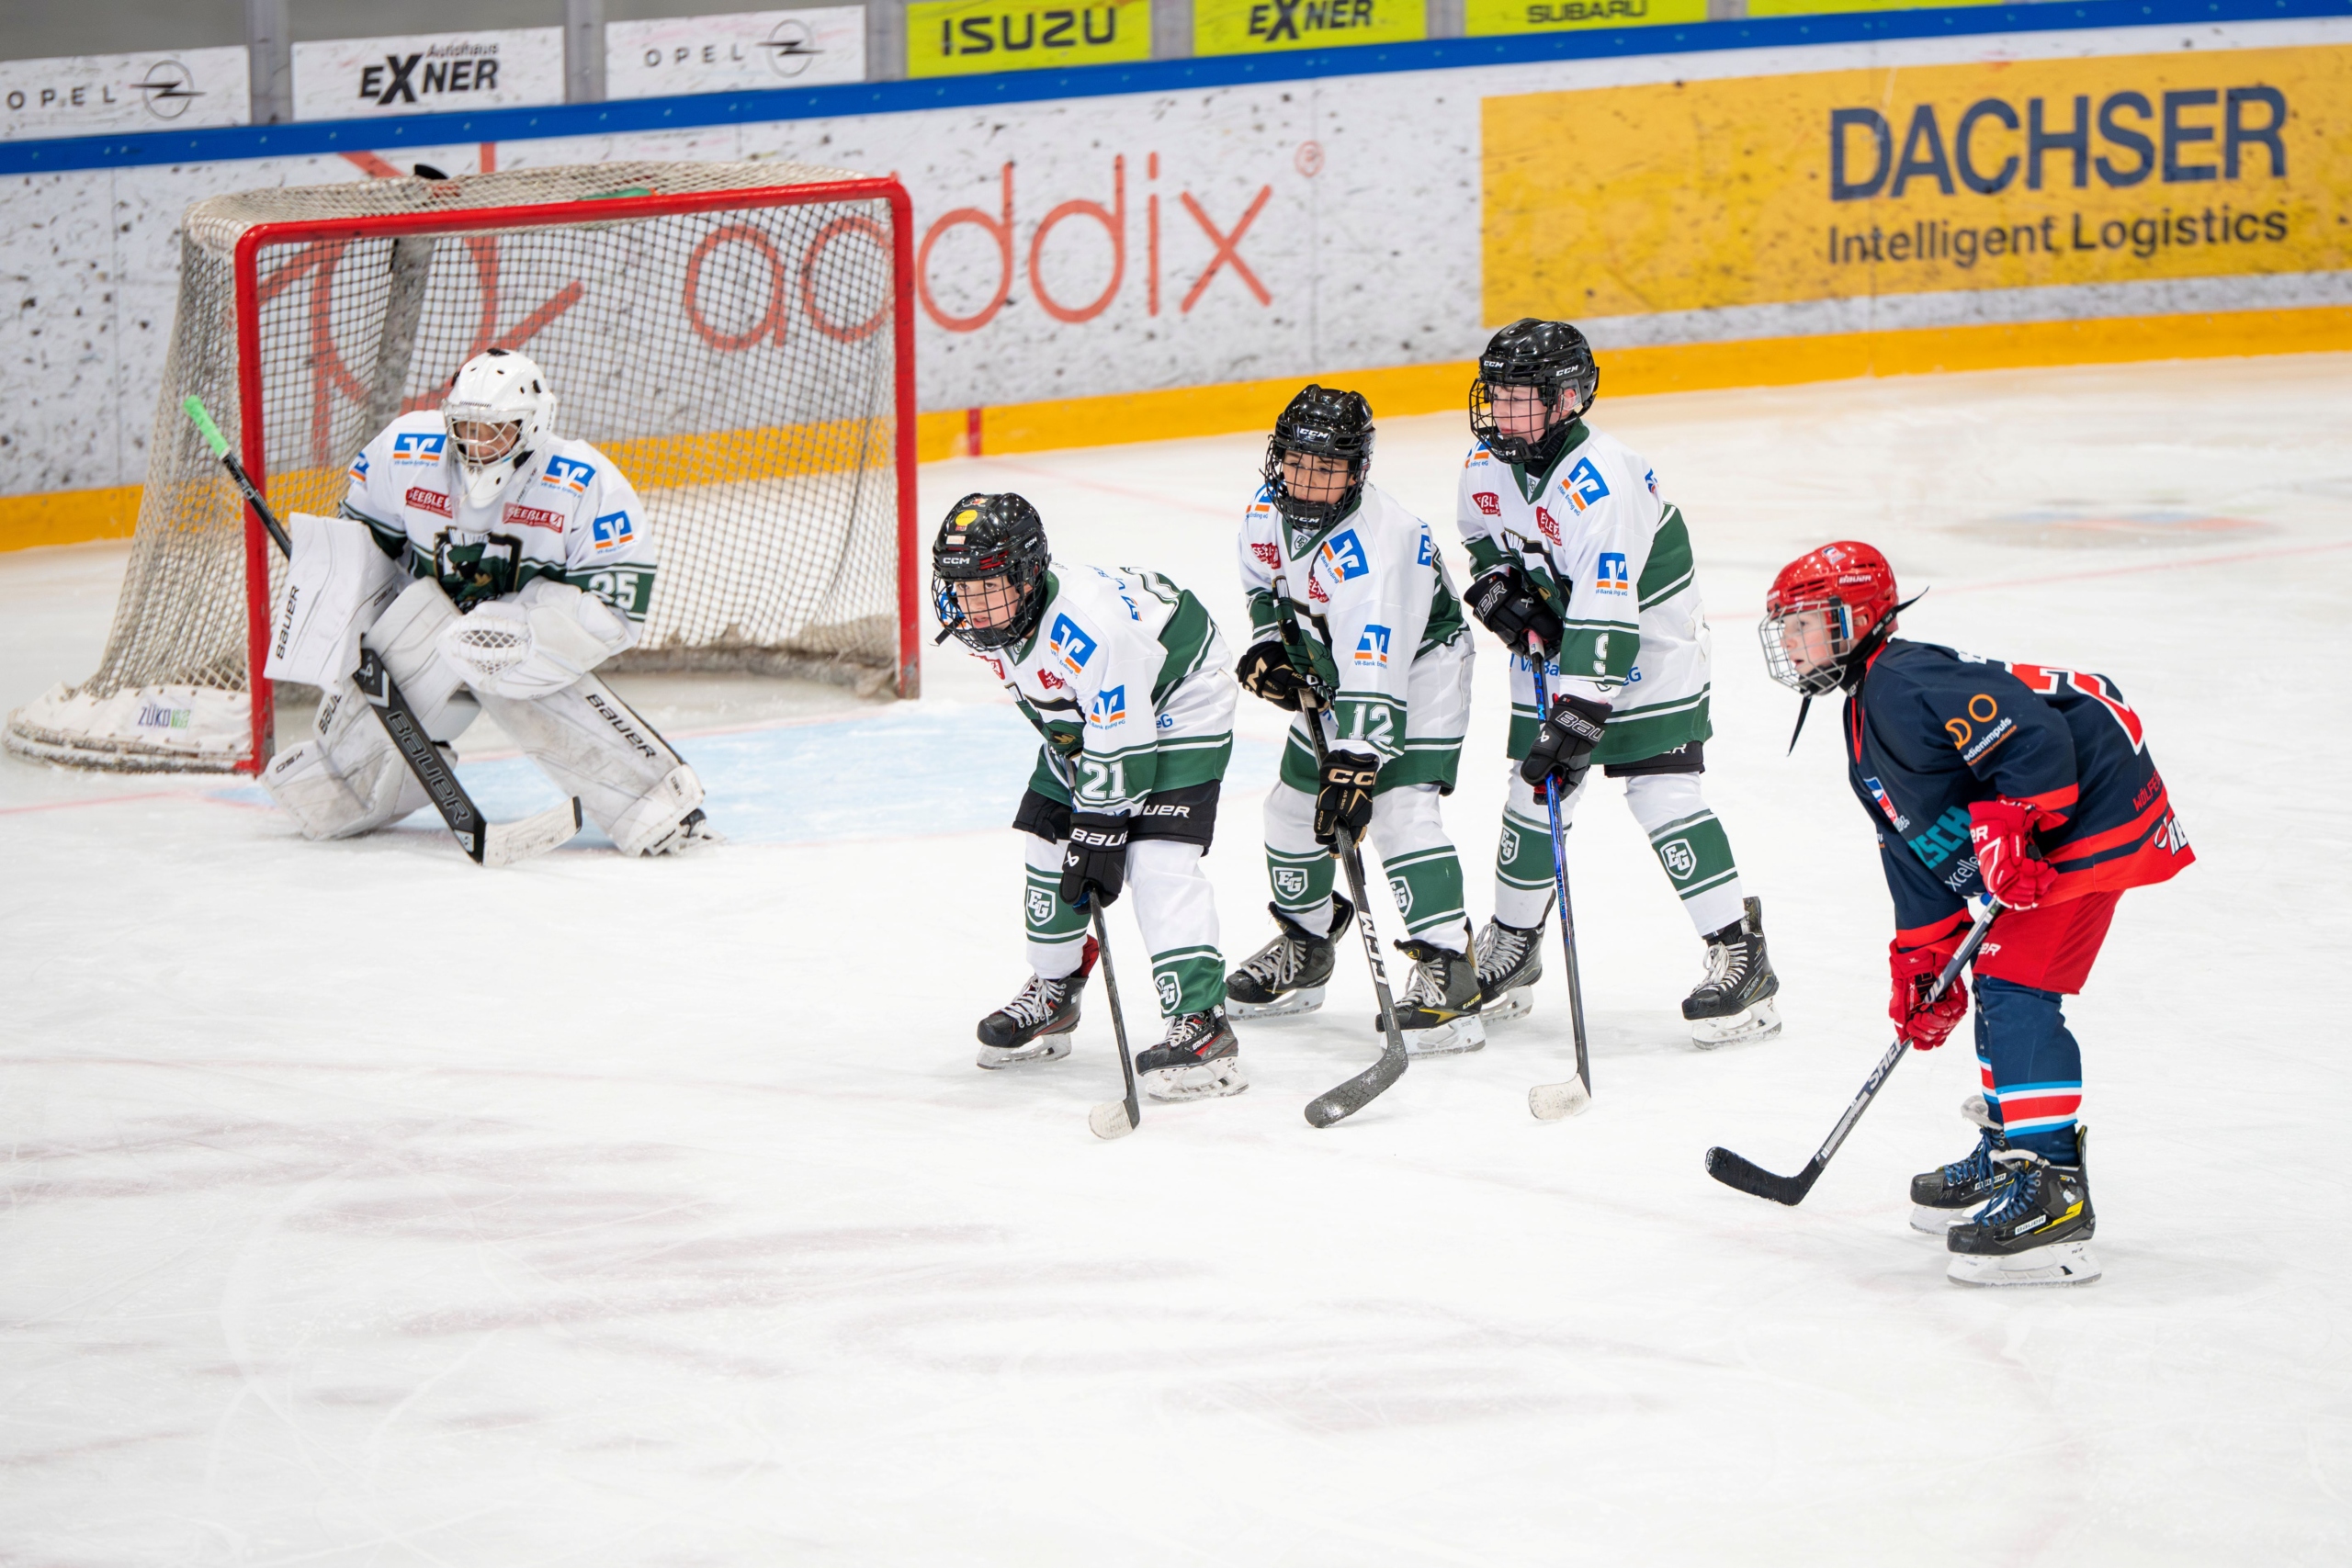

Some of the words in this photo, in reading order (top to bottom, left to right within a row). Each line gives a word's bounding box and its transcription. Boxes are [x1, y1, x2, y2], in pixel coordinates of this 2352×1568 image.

[1248, 0, 1374, 42] EXNER
[1527, 0, 1647, 24] SUBARU
[941, 6, 1116, 56] ISUZU
[425, 41, 499, 59] Autohaus
[644, 42, 743, 67] OPEL
[358, 52, 499, 107] EXNER
[6, 84, 117, 110] OPEL
[1829, 85, 2288, 202] DACHSER
[1829, 215, 2057, 268] Intelligent
[2074, 205, 2288, 259] Logistics
[1483, 360, 1505, 368] CCM
[1555, 364, 1579, 378] CCM
[1299, 427, 1330, 440] CCM
[1024, 536, 1038, 549] CCM
[943, 557, 970, 565] CCM
[588, 572, 639, 611] 25
[275, 585, 300, 660] BAUER
[585, 694, 657, 759] BAUER
[1348, 704, 1395, 746] 12
[386, 710, 471, 825] BAUER
[1080, 761, 1127, 800] 21
[1664, 845, 1691, 871] EG
[1277, 870, 1303, 893] EG
[1028, 888, 1051, 919] EG
[1358, 909, 1389, 986] CCM
[1192, 1032, 1214, 1051] BAUER
[2017, 1215, 2046, 1235] BAUER
